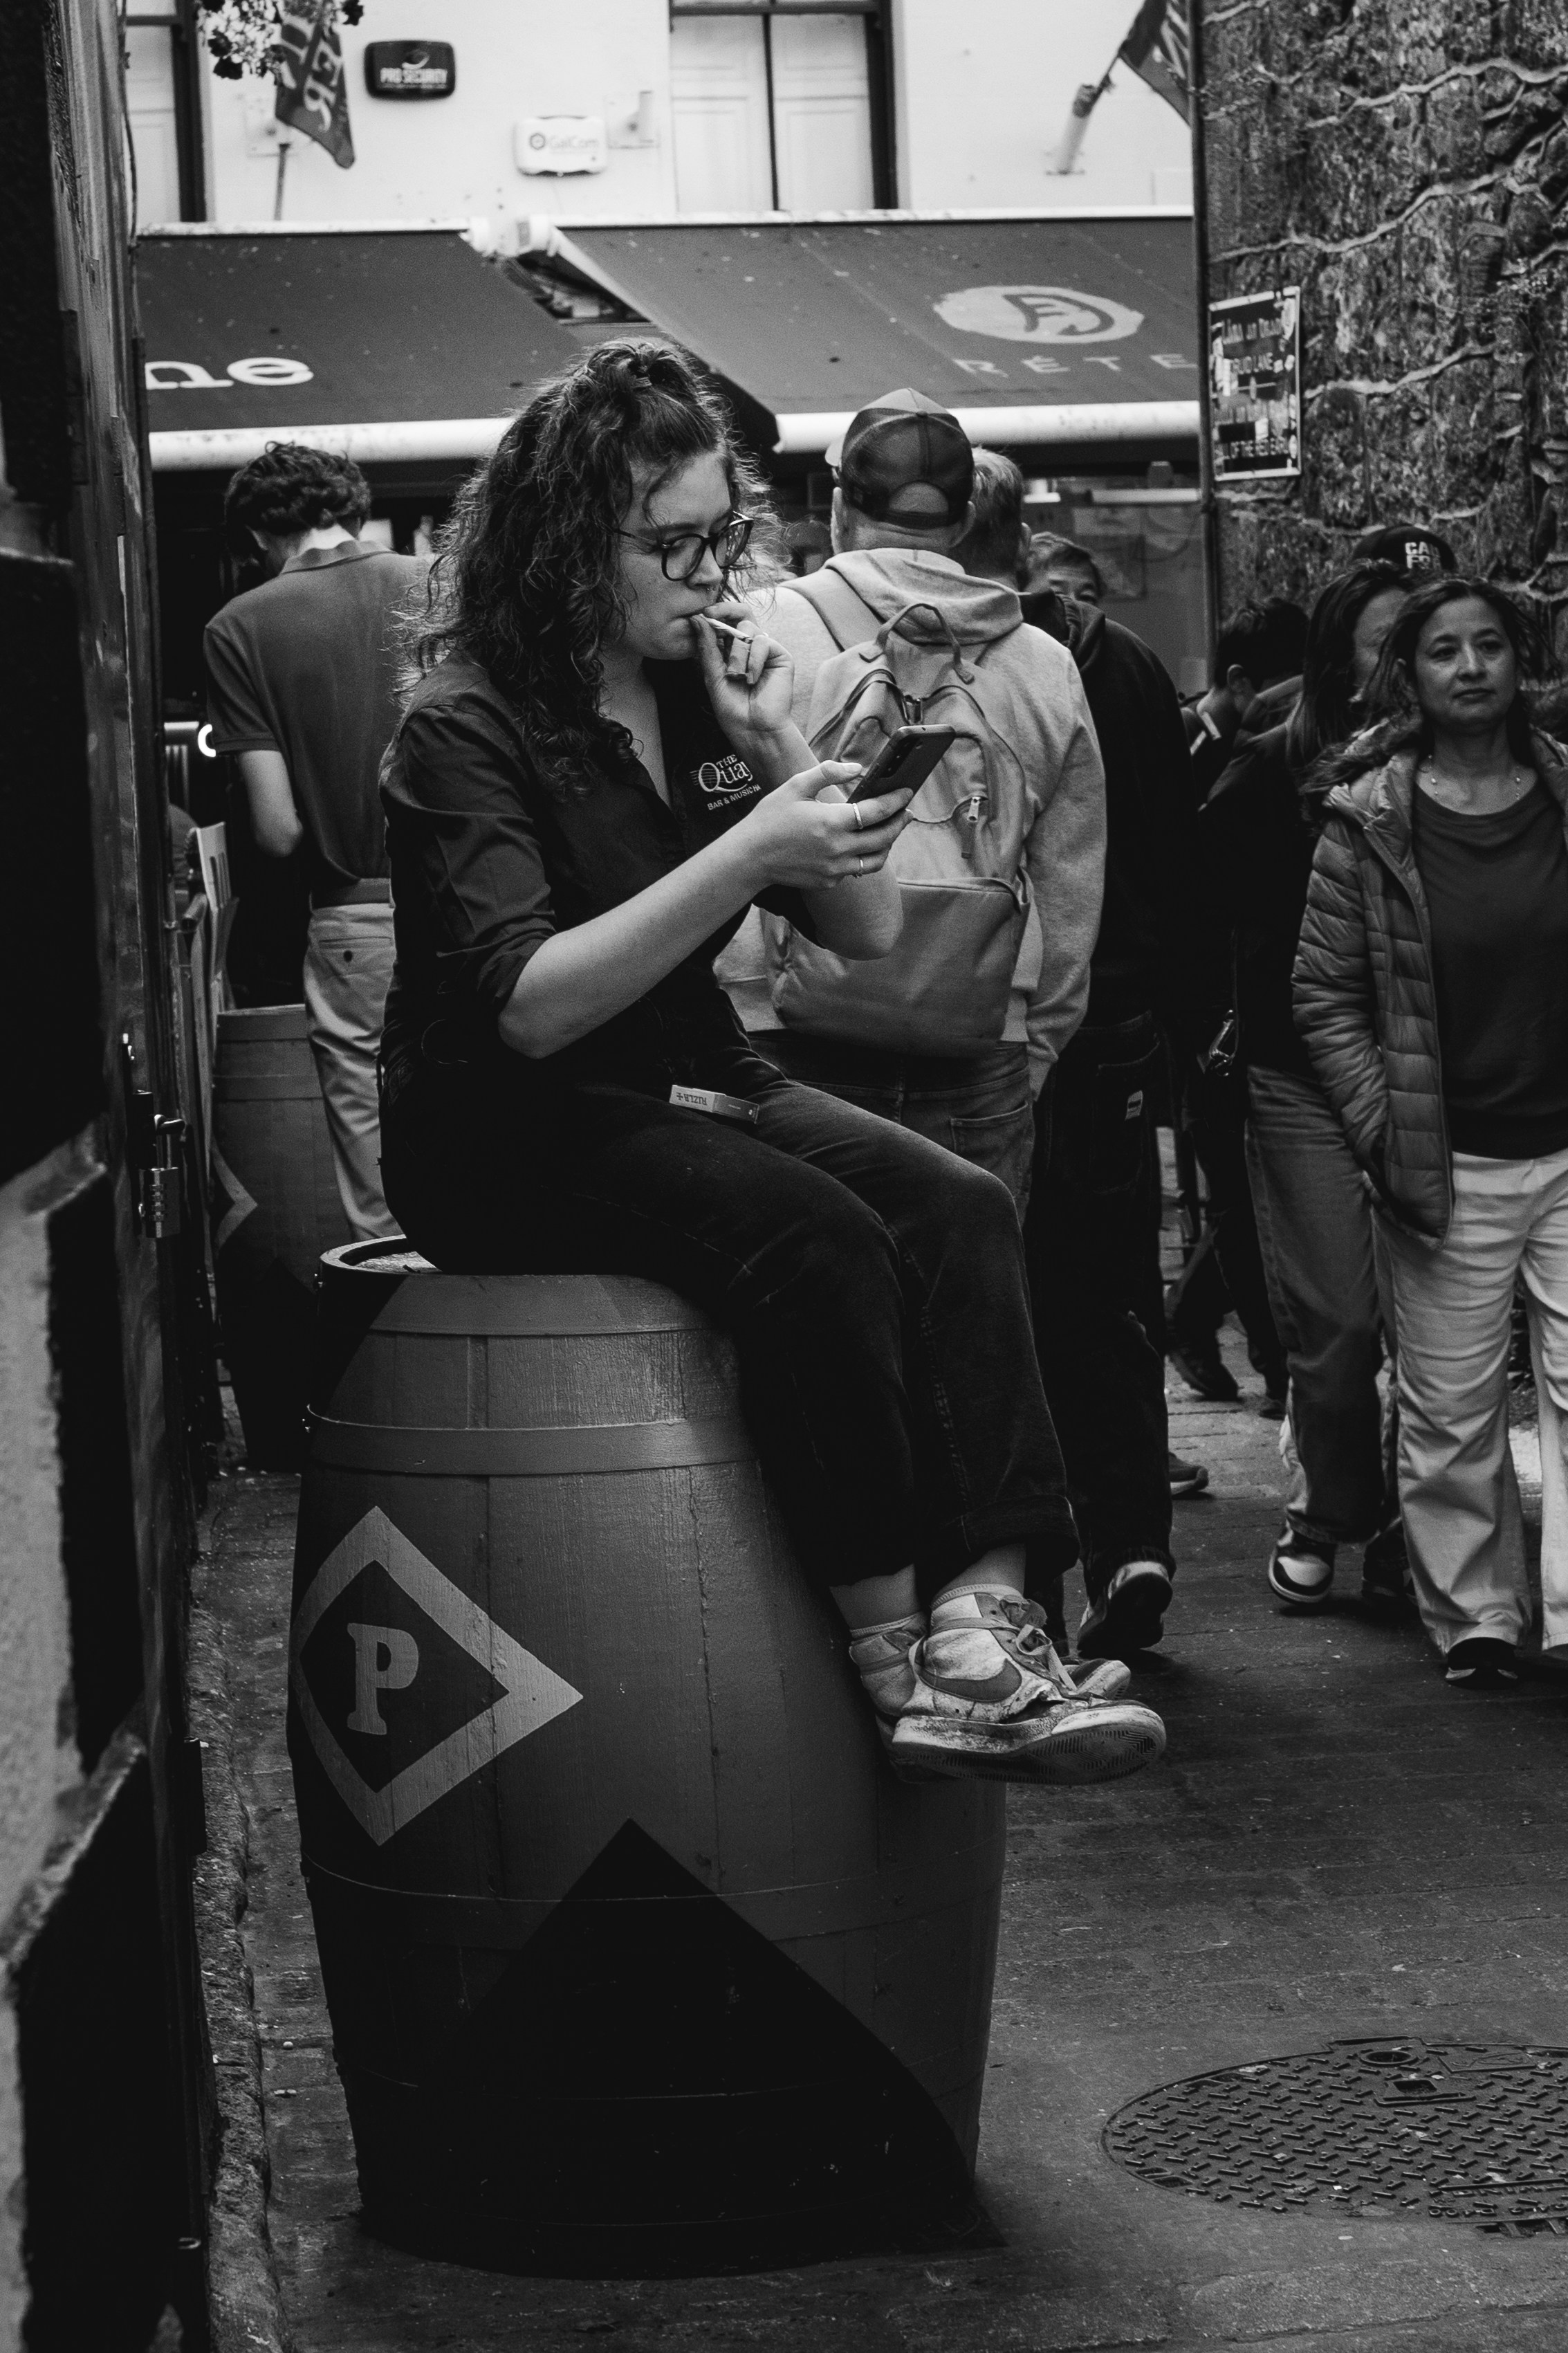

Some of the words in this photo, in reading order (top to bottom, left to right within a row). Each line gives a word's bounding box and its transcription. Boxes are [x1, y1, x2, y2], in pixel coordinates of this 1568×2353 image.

[380, 67, 402, 84] PRO
[402, 68, 448, 84] SECURITY
[717, 754, 737, 769] THE
[699, 762, 753, 792] Quay
[707, 799, 723, 811] BAR
[730, 787, 753, 802] MUSIC
[347, 1622, 419, 1735] P
